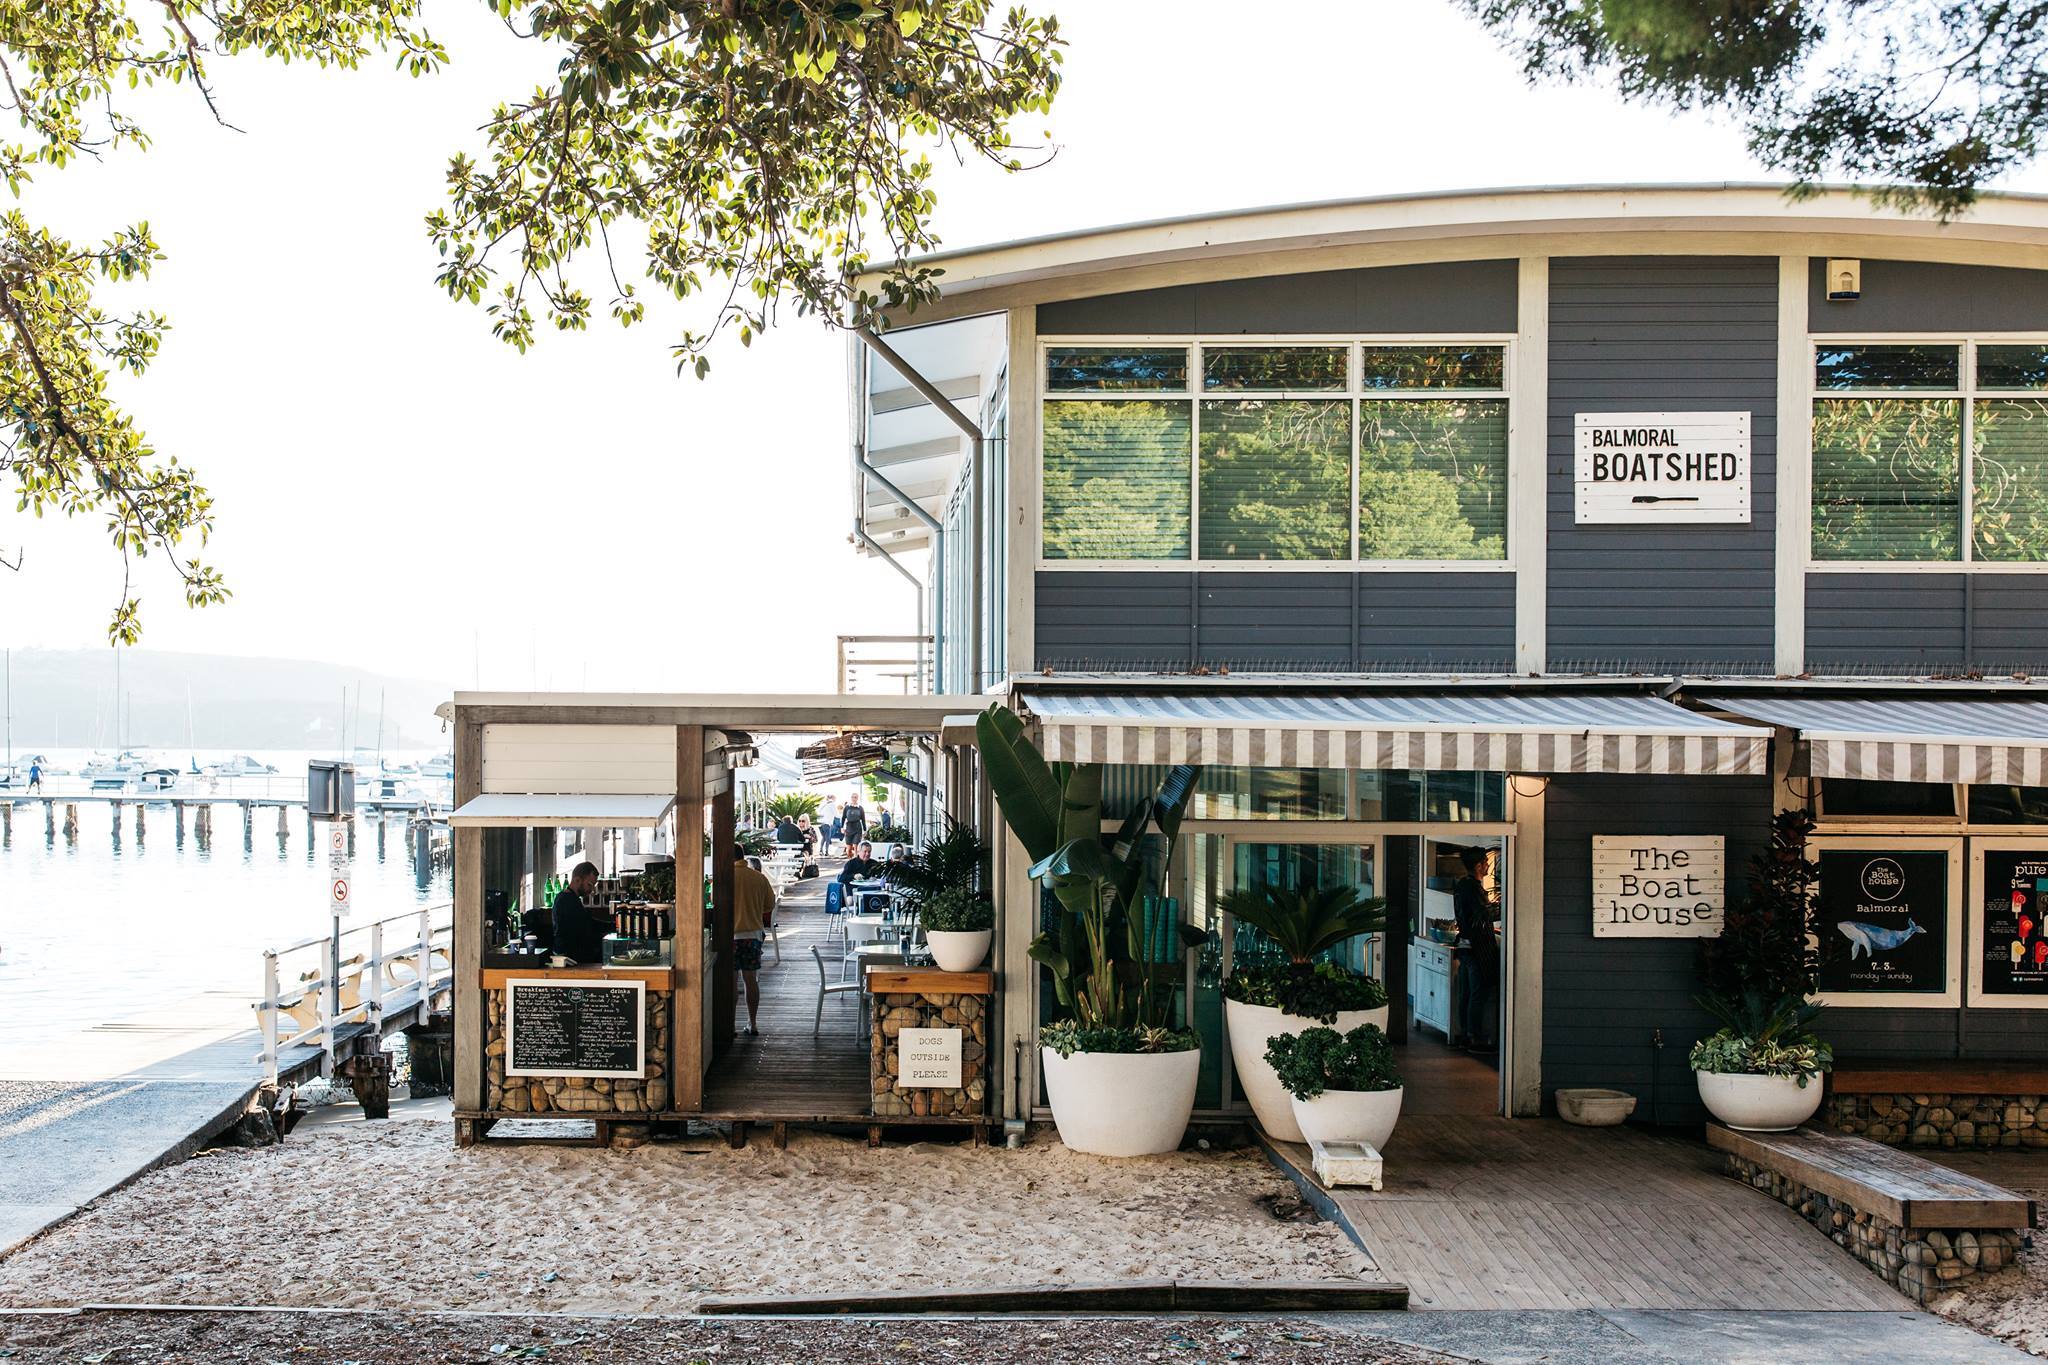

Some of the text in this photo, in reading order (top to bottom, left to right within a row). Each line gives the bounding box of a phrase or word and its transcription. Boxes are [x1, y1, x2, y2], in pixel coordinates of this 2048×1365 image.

[1593, 429, 1679, 447] BALMORAL
[1593, 453, 1737, 481] BOATSHED
[1630, 847, 1689, 871] The
[1871, 871, 1896, 879] Boat
[2014, 865, 2047, 877] pure
[1868, 876, 1899, 885] house
[1619, 874, 1702, 899] Boat
[1610, 900, 1712, 926] house
[1856, 904, 1909, 913] Balmoral
[1850, 972, 1880, 983] monday
[1887, 972, 1913, 983] sunday
[919, 1037, 943, 1045] DOGS
[912, 1070, 948, 1079] PLEASE
